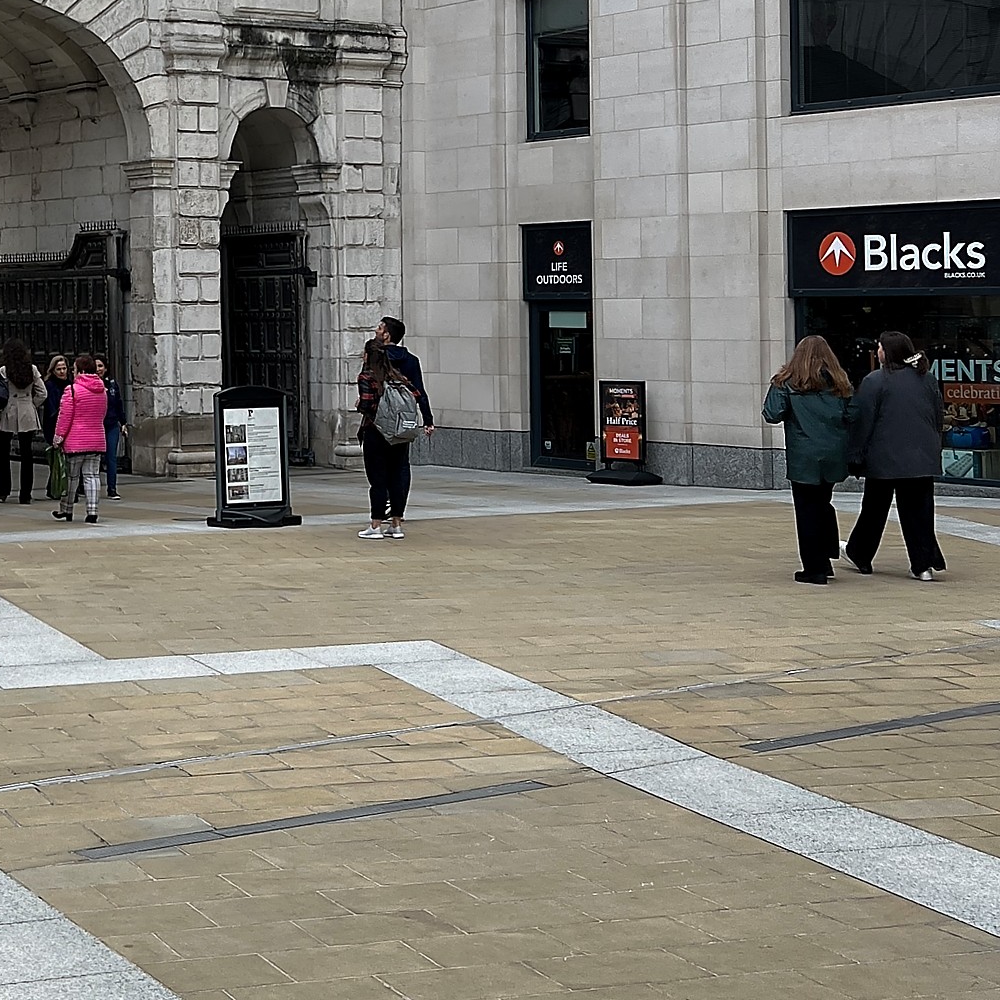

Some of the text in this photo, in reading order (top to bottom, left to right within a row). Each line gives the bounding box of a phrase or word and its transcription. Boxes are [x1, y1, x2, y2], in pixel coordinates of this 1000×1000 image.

[863, 231, 986, 271] Blacks
[551, 262, 568, 271] LIFE
[536, 274, 583, 284] OUTDOORS
[944, 271, 986, 279] BLACKS.CO.UK
[946, 384, 1000, 400] celebrati
[606, 416, 637, 425] Half Price
